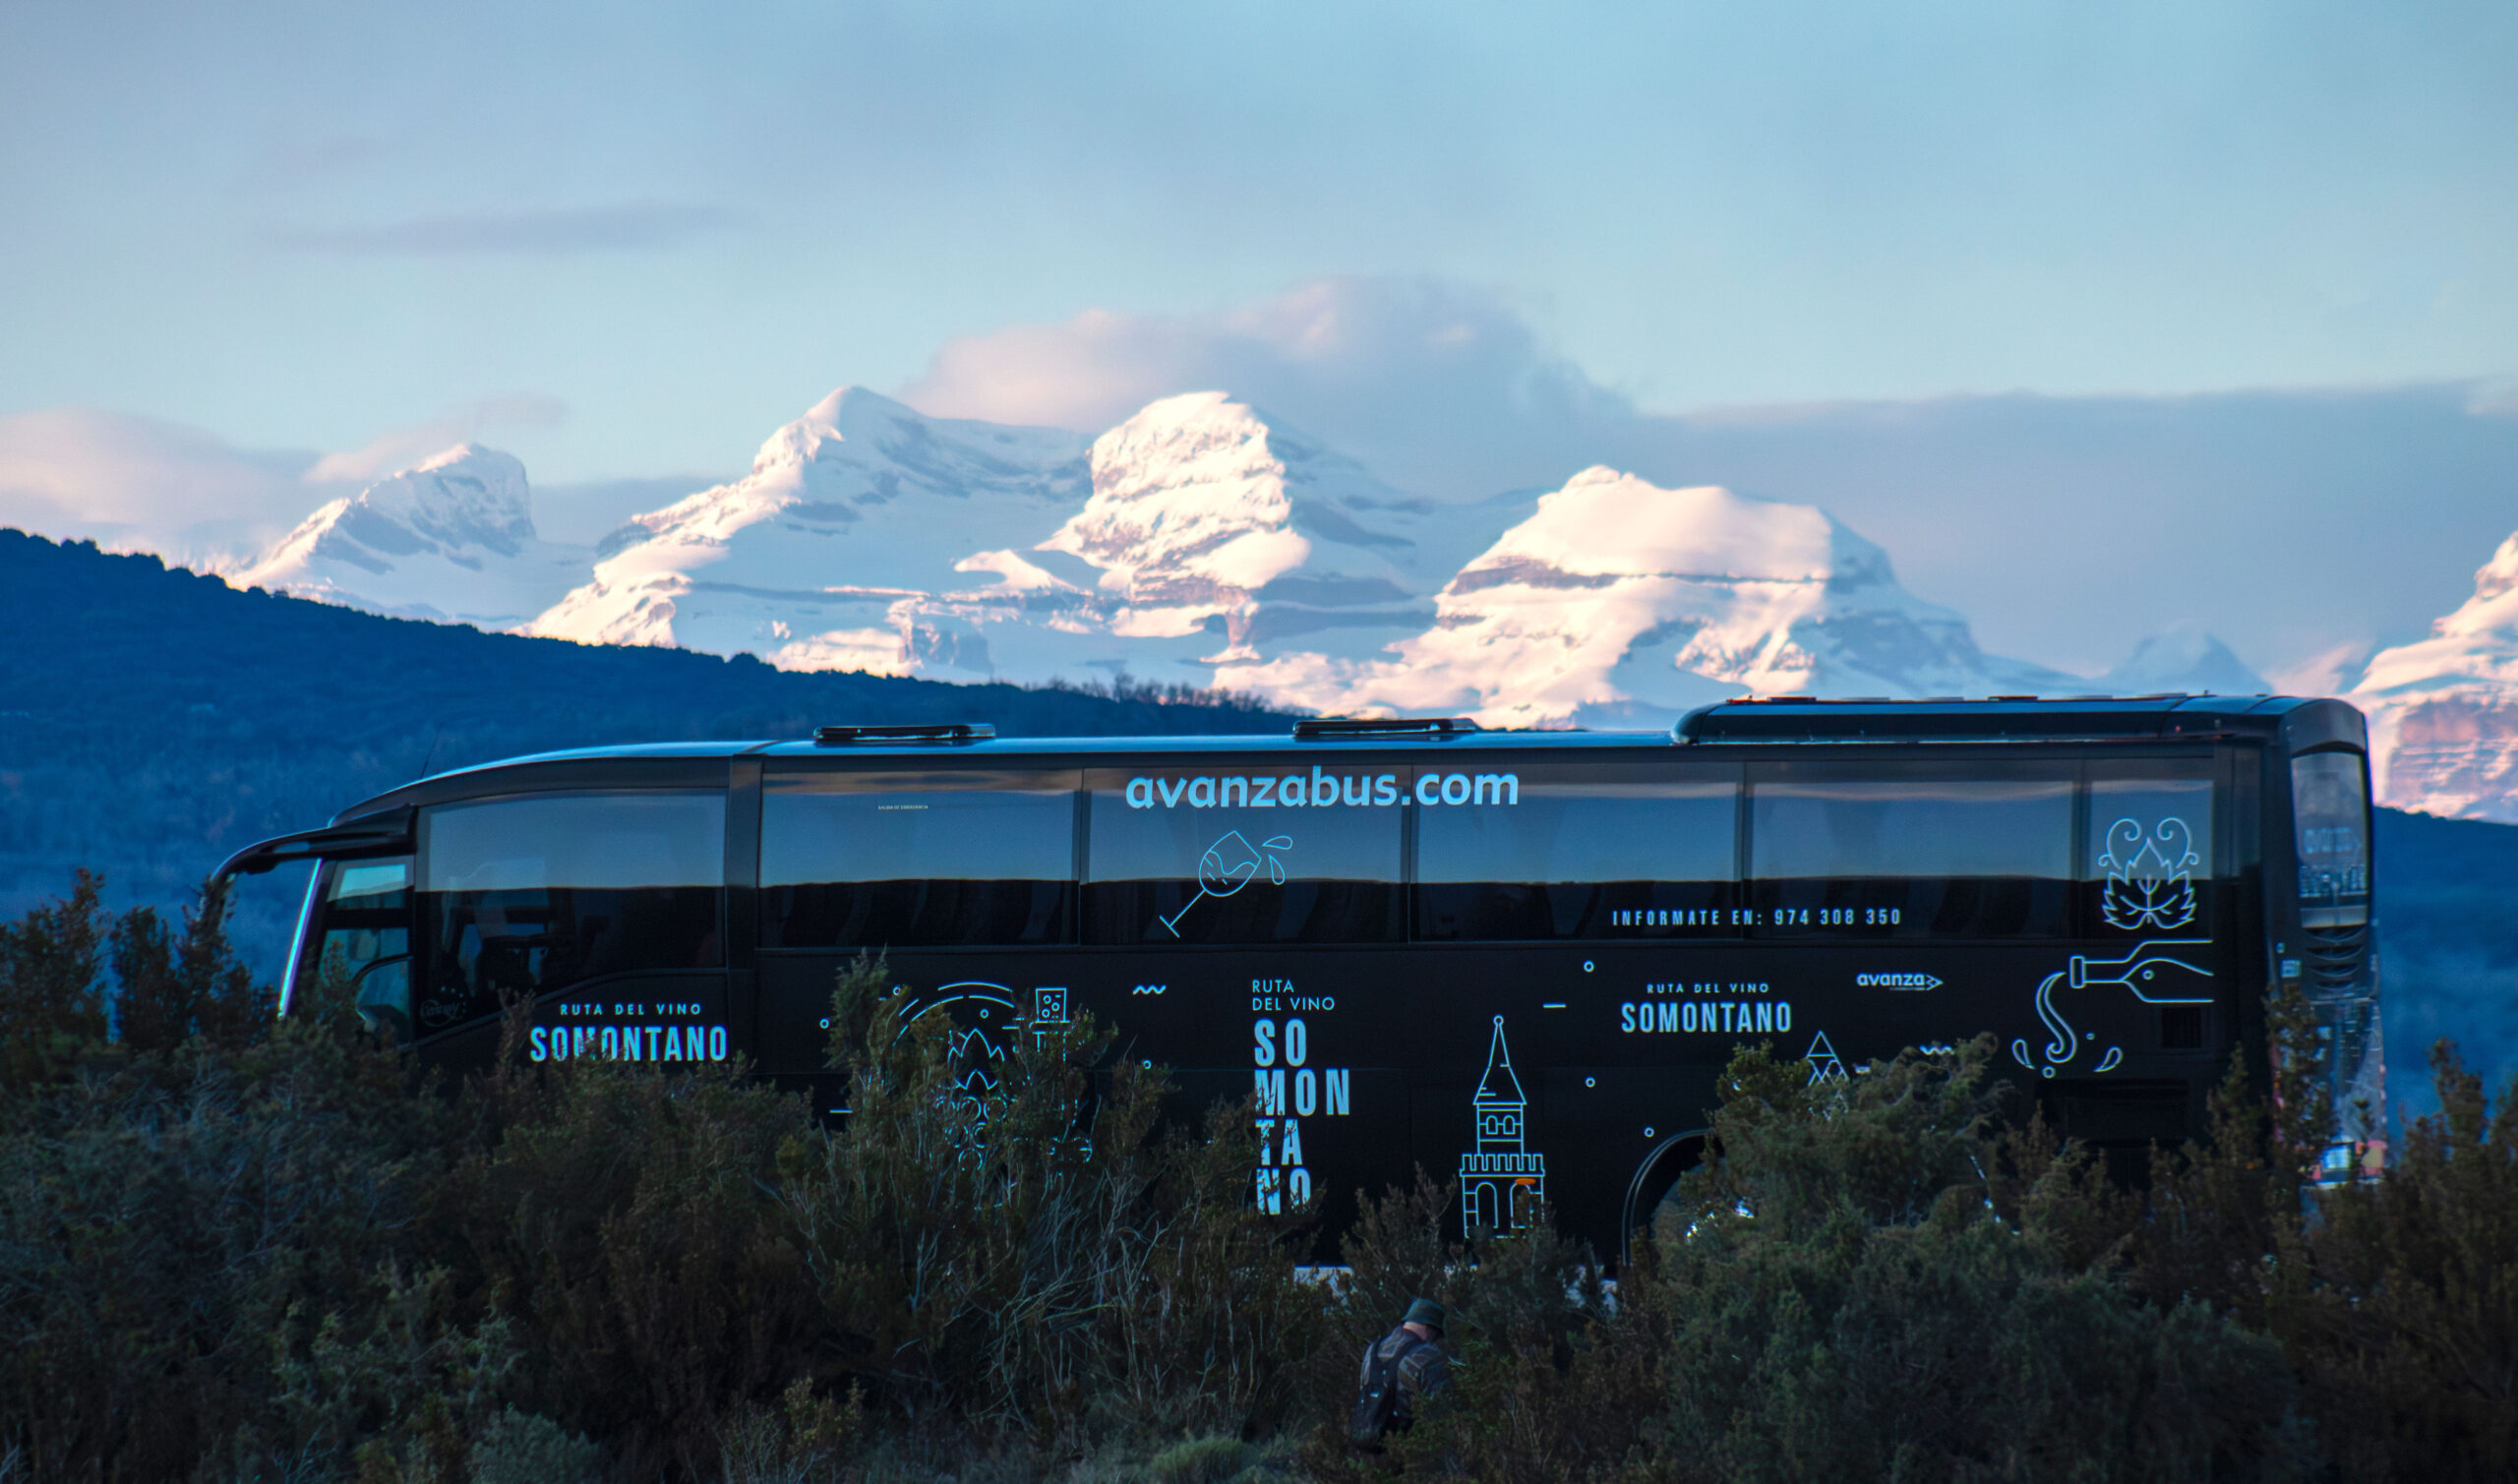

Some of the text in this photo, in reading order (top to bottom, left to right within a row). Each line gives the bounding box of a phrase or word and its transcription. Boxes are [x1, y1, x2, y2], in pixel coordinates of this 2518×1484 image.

[1124, 765, 1520, 809] avanzabus.com
[1612, 908, 1901, 926] INFORMATE EN: 974 308 350
[1252, 979, 1294, 993] RUTA
[1647, 982, 1769, 994] RUTA DEL VINO
[1855, 973, 1925, 986] avanza
[560, 1003, 702, 1016] RUTA DEL VINO
[1252, 996, 1335, 1011] DEL VINO
[1621, 1001, 1791, 1034] SOMONTANO
[529, 1026, 728, 1062] SOMONTANO
[1253, 1018, 1307, 1067] SO
[1254, 1068, 1350, 1117] MON
[1255, 1118, 1303, 1166] TA
[1256, 1167, 1312, 1217] NO
